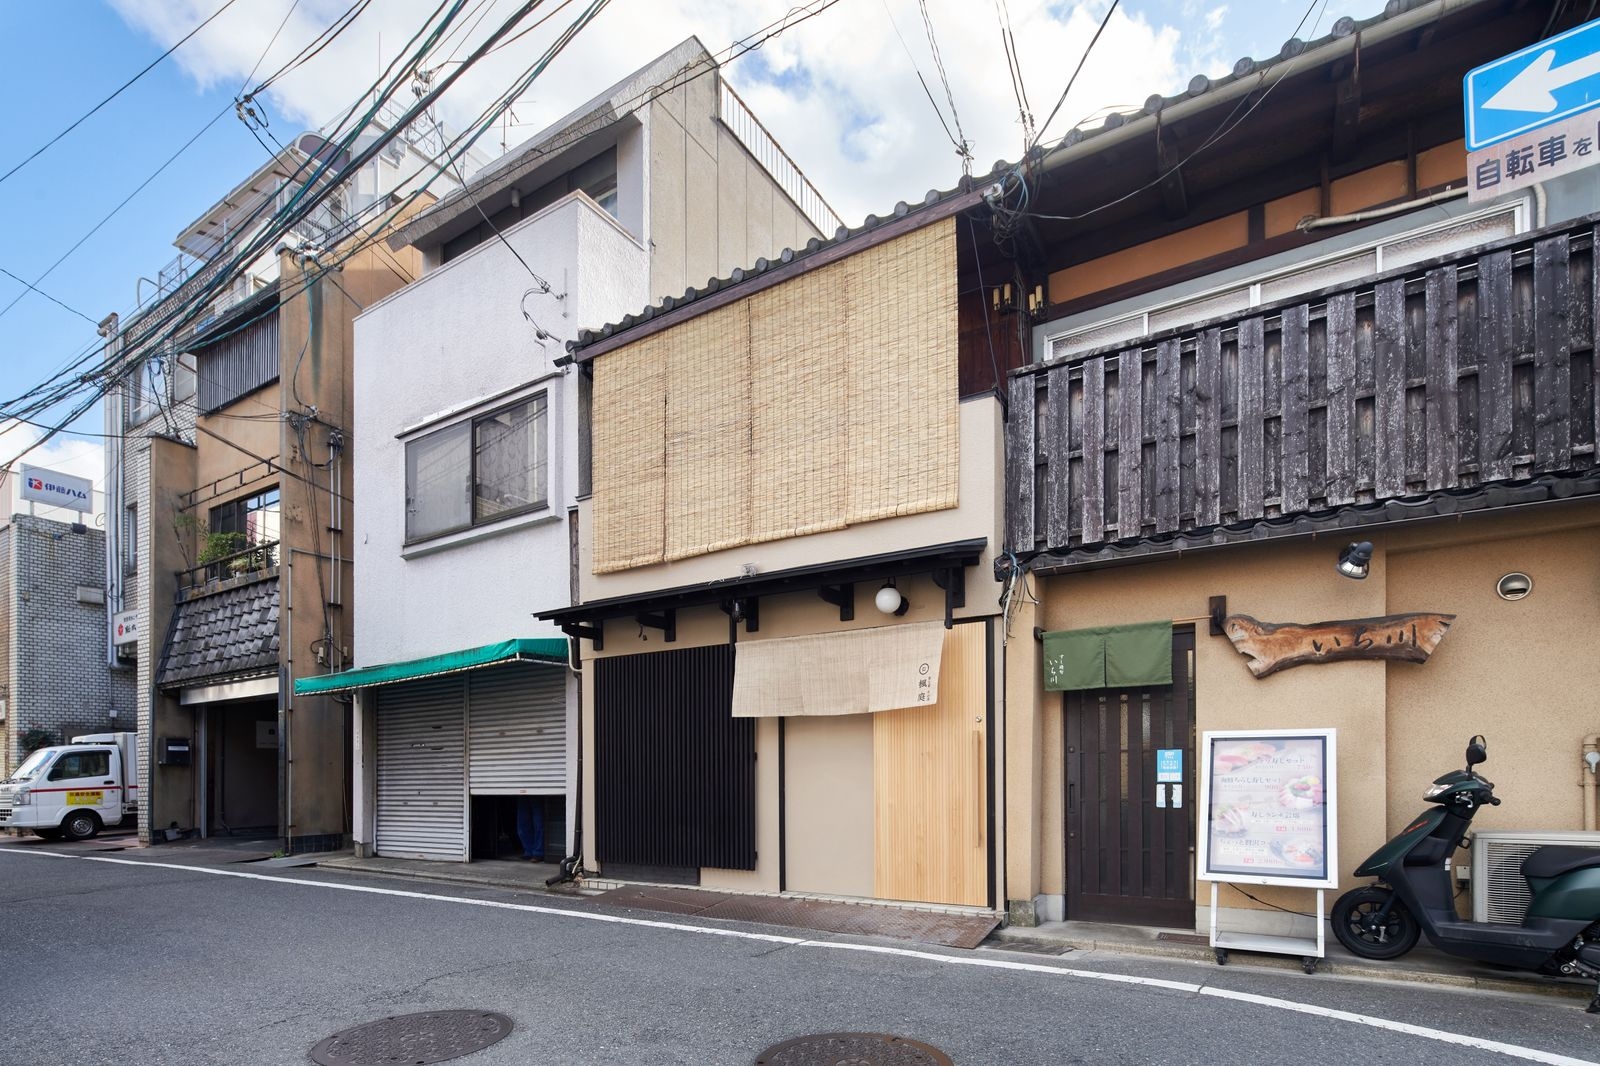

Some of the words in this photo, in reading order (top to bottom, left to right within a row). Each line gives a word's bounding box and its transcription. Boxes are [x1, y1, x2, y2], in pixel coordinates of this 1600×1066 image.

[1476, 120, 1600, 190] 自転車を
[44, 482, 87, 499] 伊藤ハム
[1311, 623, 1417, 653] いち川
[1049, 659, 1058, 684] いち川
[917, 679, 927, 702] 楓庭
